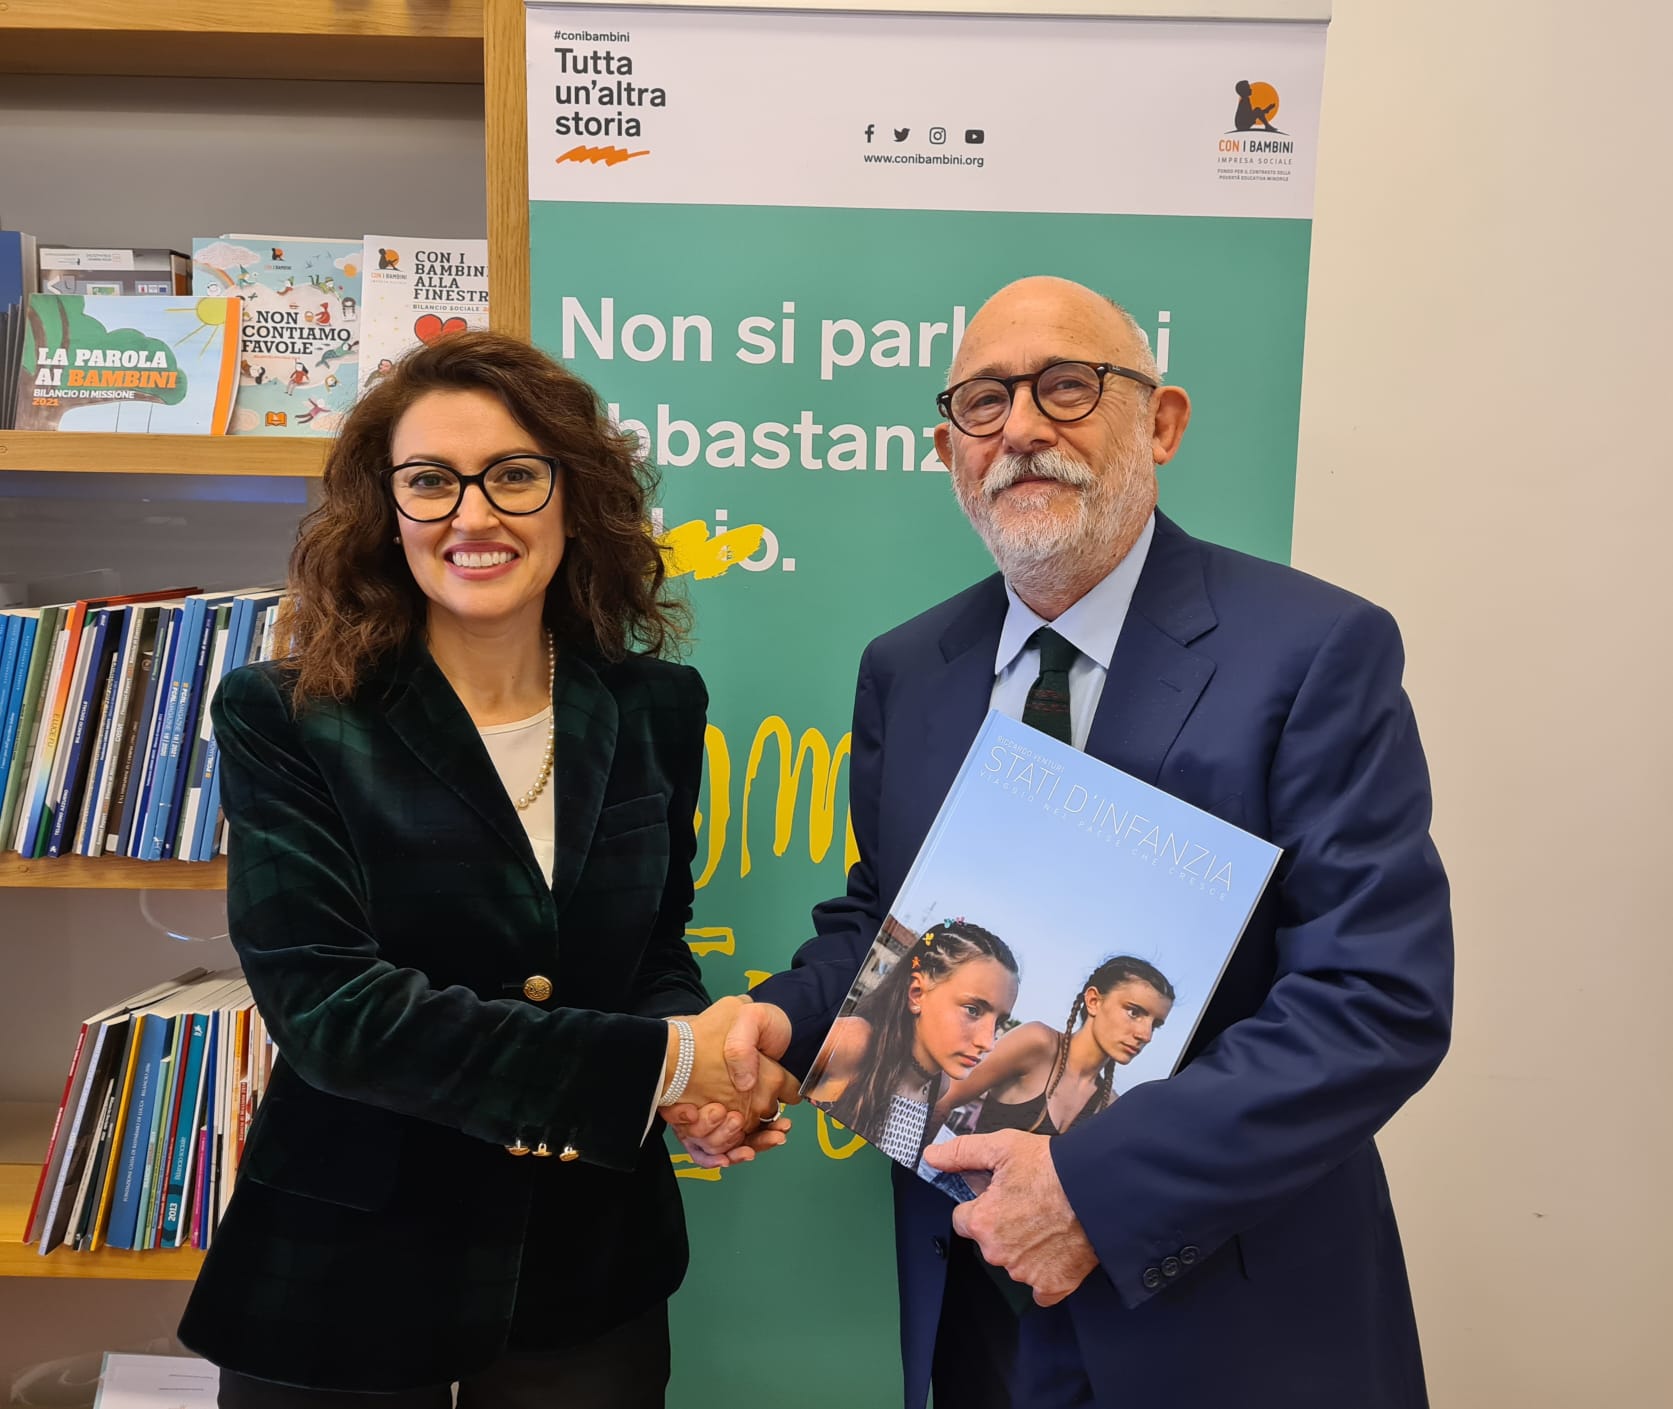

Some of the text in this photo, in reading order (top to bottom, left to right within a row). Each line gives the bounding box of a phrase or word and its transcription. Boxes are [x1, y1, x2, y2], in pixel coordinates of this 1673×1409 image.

[554, 30, 630, 43] #conibambini
[554, 47, 633, 75] Tutta
[555, 80, 666, 107] un'altra
[555, 111, 641, 137] storia
[1218, 139, 1294, 154] CON I BAMBINI
[864, 153, 984, 168] www.conibambini.org
[415, 250, 465, 264] CON I
[414, 263, 488, 278] BAMBIN
[414, 276, 460, 289] ALLA
[413, 288, 489, 302] FINESTR
[256, 310, 299, 325] NON
[242, 325, 351, 342] CONTIAMO
[562, 296, 966, 380] Non si parl
[241, 339, 313, 355] FAVOLE
[37, 348, 168, 368] LA PAROLA
[34, 368, 178, 388] AI BAMBINI
[33, 389, 136, 400] BILANCIO DI MISSIONE
[600, 403, 950, 472] bbastanz
[997, 735, 1065, 773] RICCARDO VENTURI
[55, 811, 64, 835] TELEFONO
[74, 720, 84, 743] BILANCIO
[79, 699, 88, 720] SOCIALE
[980, 770, 1034, 803] VIAGGIO
[984, 745, 1235, 892] STATI D'INFANZIA
[167, 1202, 178, 1222] 2013
